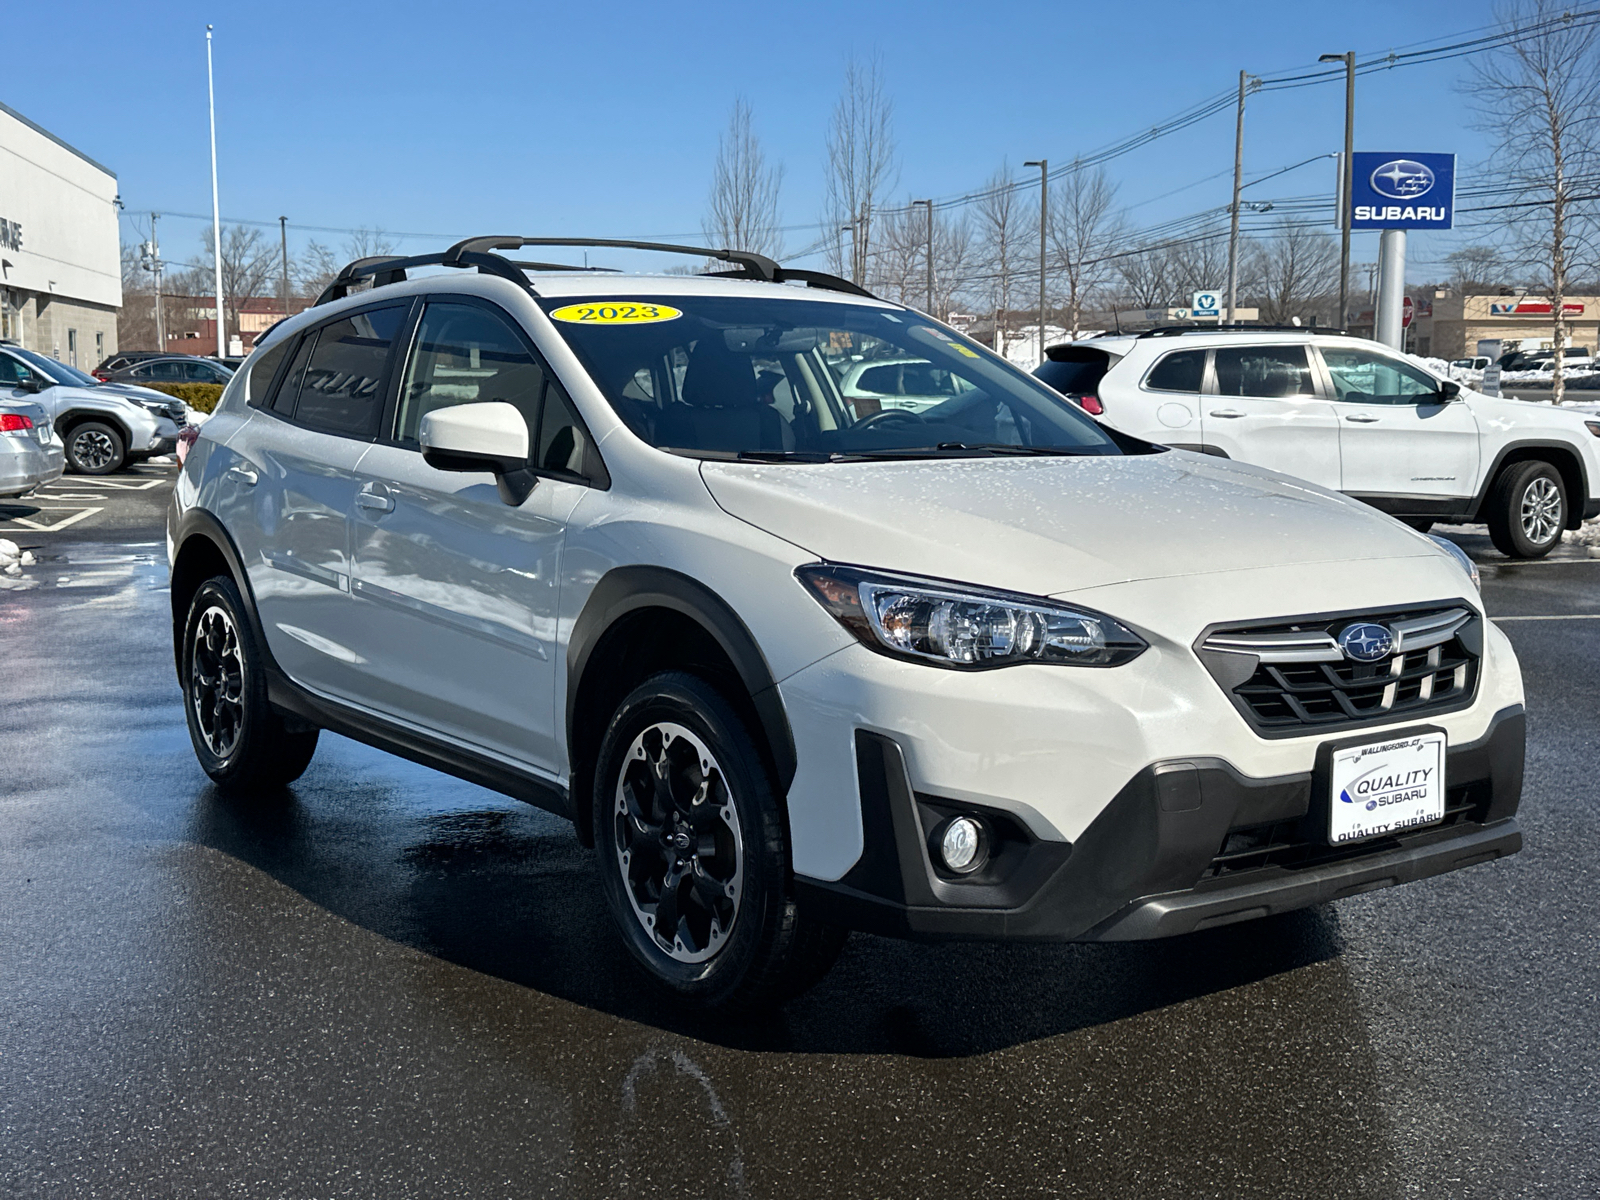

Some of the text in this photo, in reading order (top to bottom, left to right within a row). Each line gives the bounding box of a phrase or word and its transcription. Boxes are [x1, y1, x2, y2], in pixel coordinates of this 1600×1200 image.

[1354, 206, 1445, 221] SUBARU
[577, 306, 660, 321] 2023
[1357, 767, 1433, 794] QUALITY
[1378, 788, 1427, 807] SUBARU
[1338, 811, 1441, 842] QUALITY SUBARU
